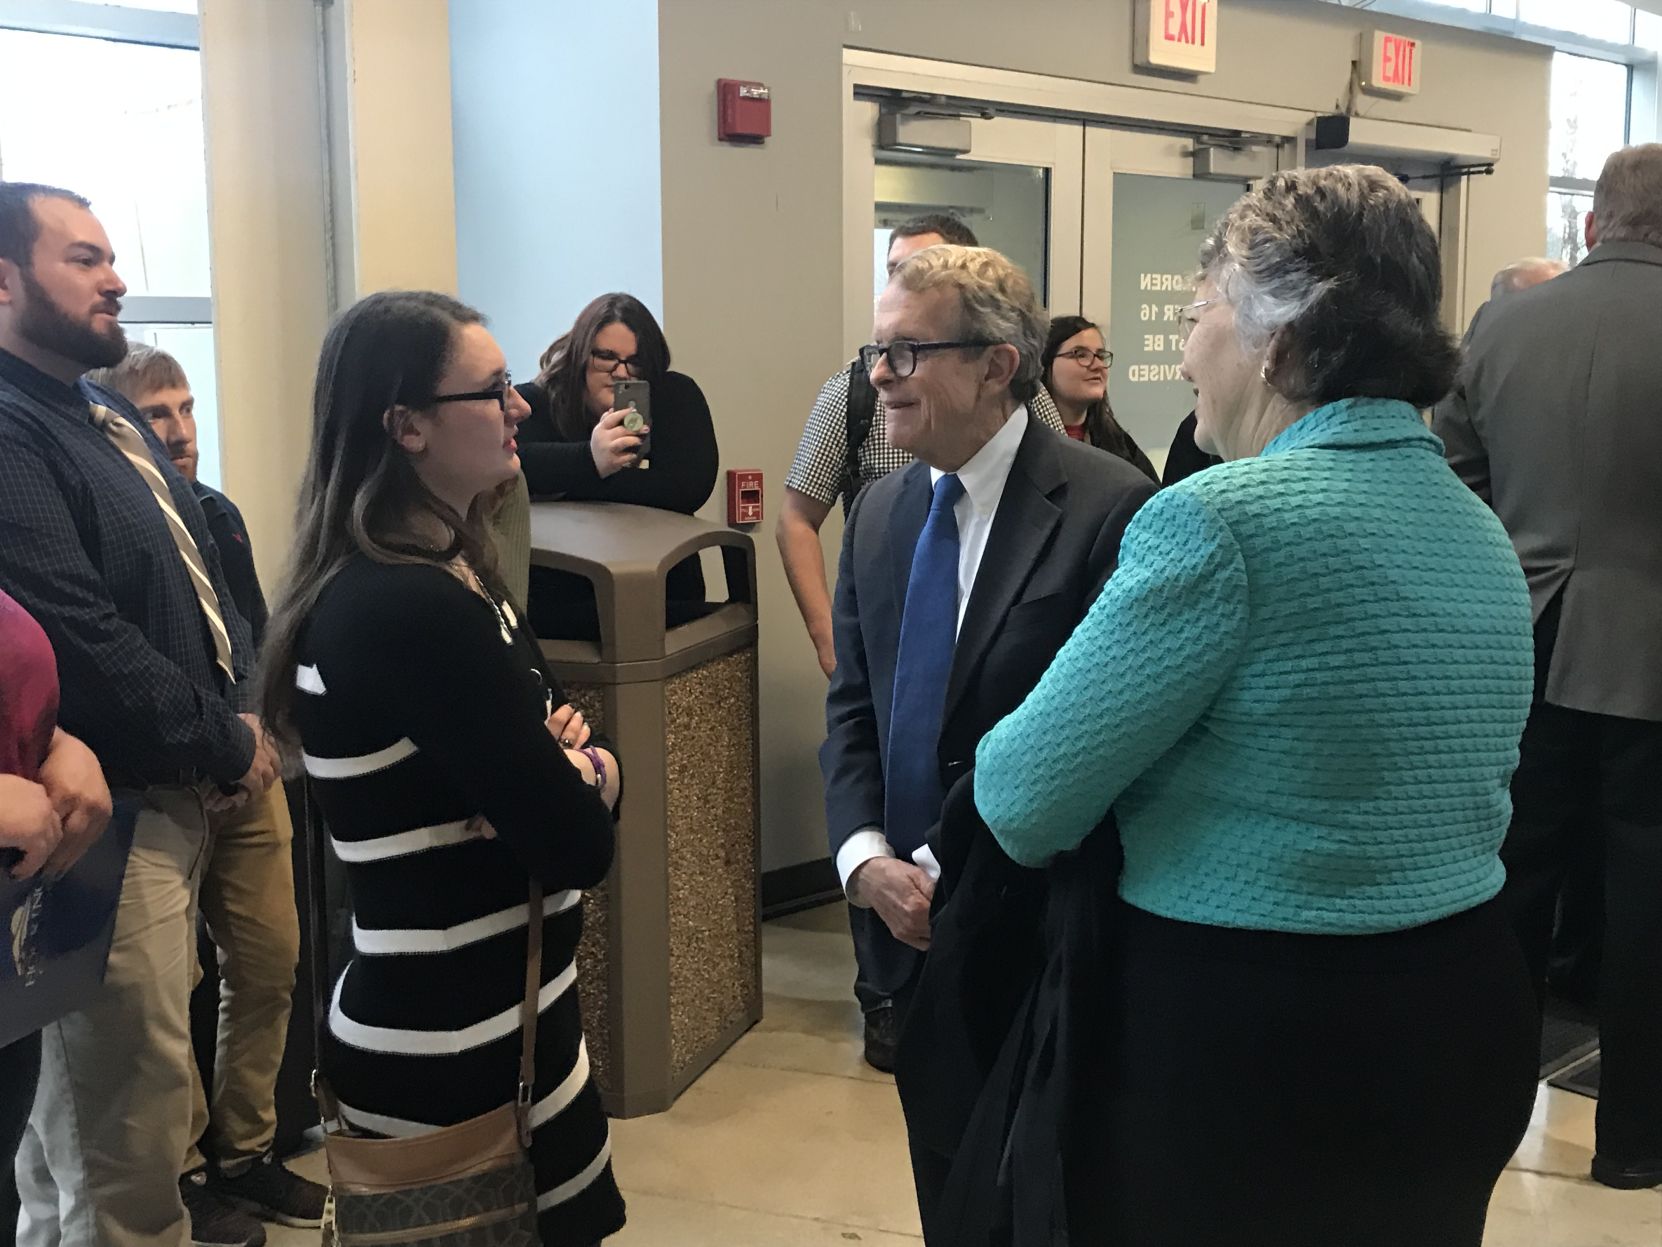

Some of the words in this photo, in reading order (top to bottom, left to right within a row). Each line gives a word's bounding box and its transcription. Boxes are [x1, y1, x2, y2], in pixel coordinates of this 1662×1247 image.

[1164, 0, 1210, 47] EXIT
[1382, 34, 1416, 88] EXIT
[741, 480, 760, 489] FIRE
